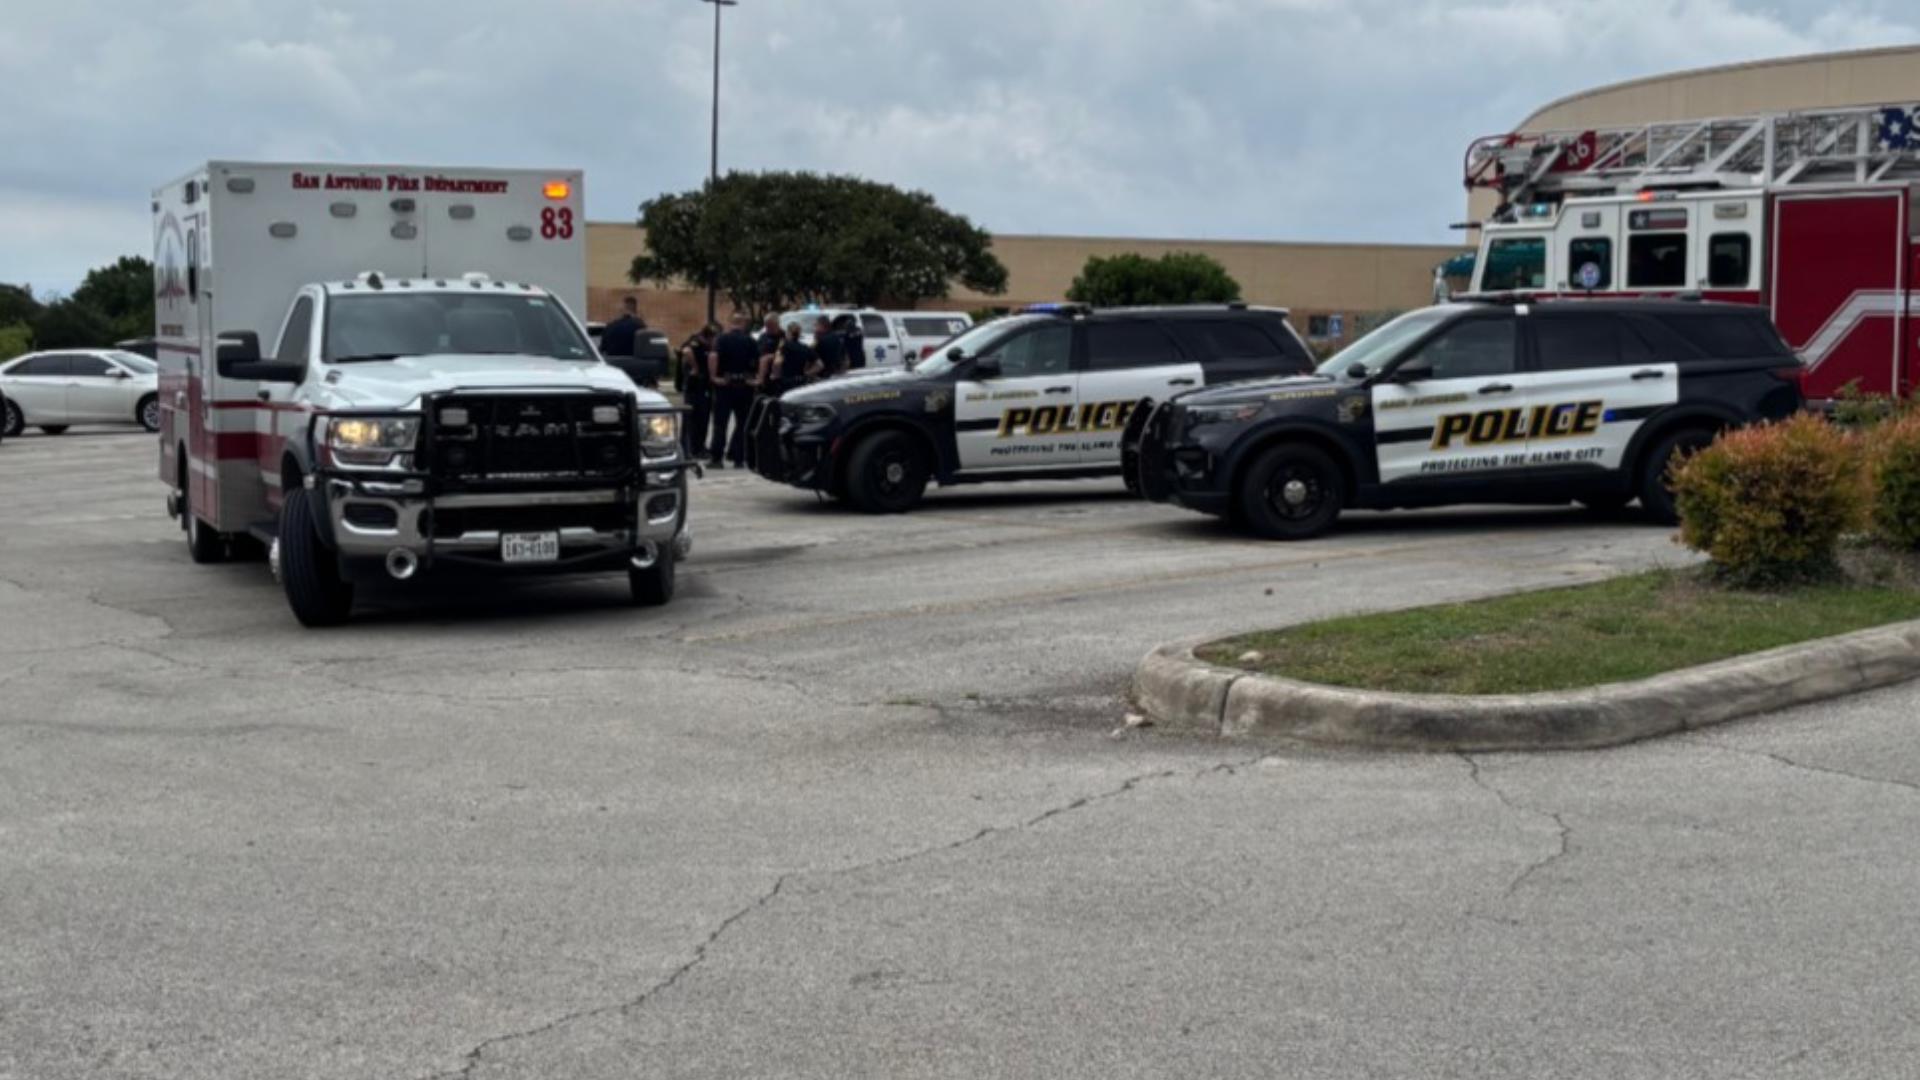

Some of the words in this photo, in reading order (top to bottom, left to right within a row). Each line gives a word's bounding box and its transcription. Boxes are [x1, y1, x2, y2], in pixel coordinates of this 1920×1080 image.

[292, 173, 320, 189] SAN
[324, 174, 382, 191] ANTONIO
[387, 175, 419, 191] FIRE
[424, 175, 508, 193] DEPARTMENT
[540, 207, 573, 240] 83
[1429, 400, 1604, 451] POLICE
[1421, 455, 1499, 472] PROTECTING
[1503, 453, 1525, 466] THE
[1530, 449, 1572, 463] ALAMO
[1575, 447, 1605, 460] CITY
